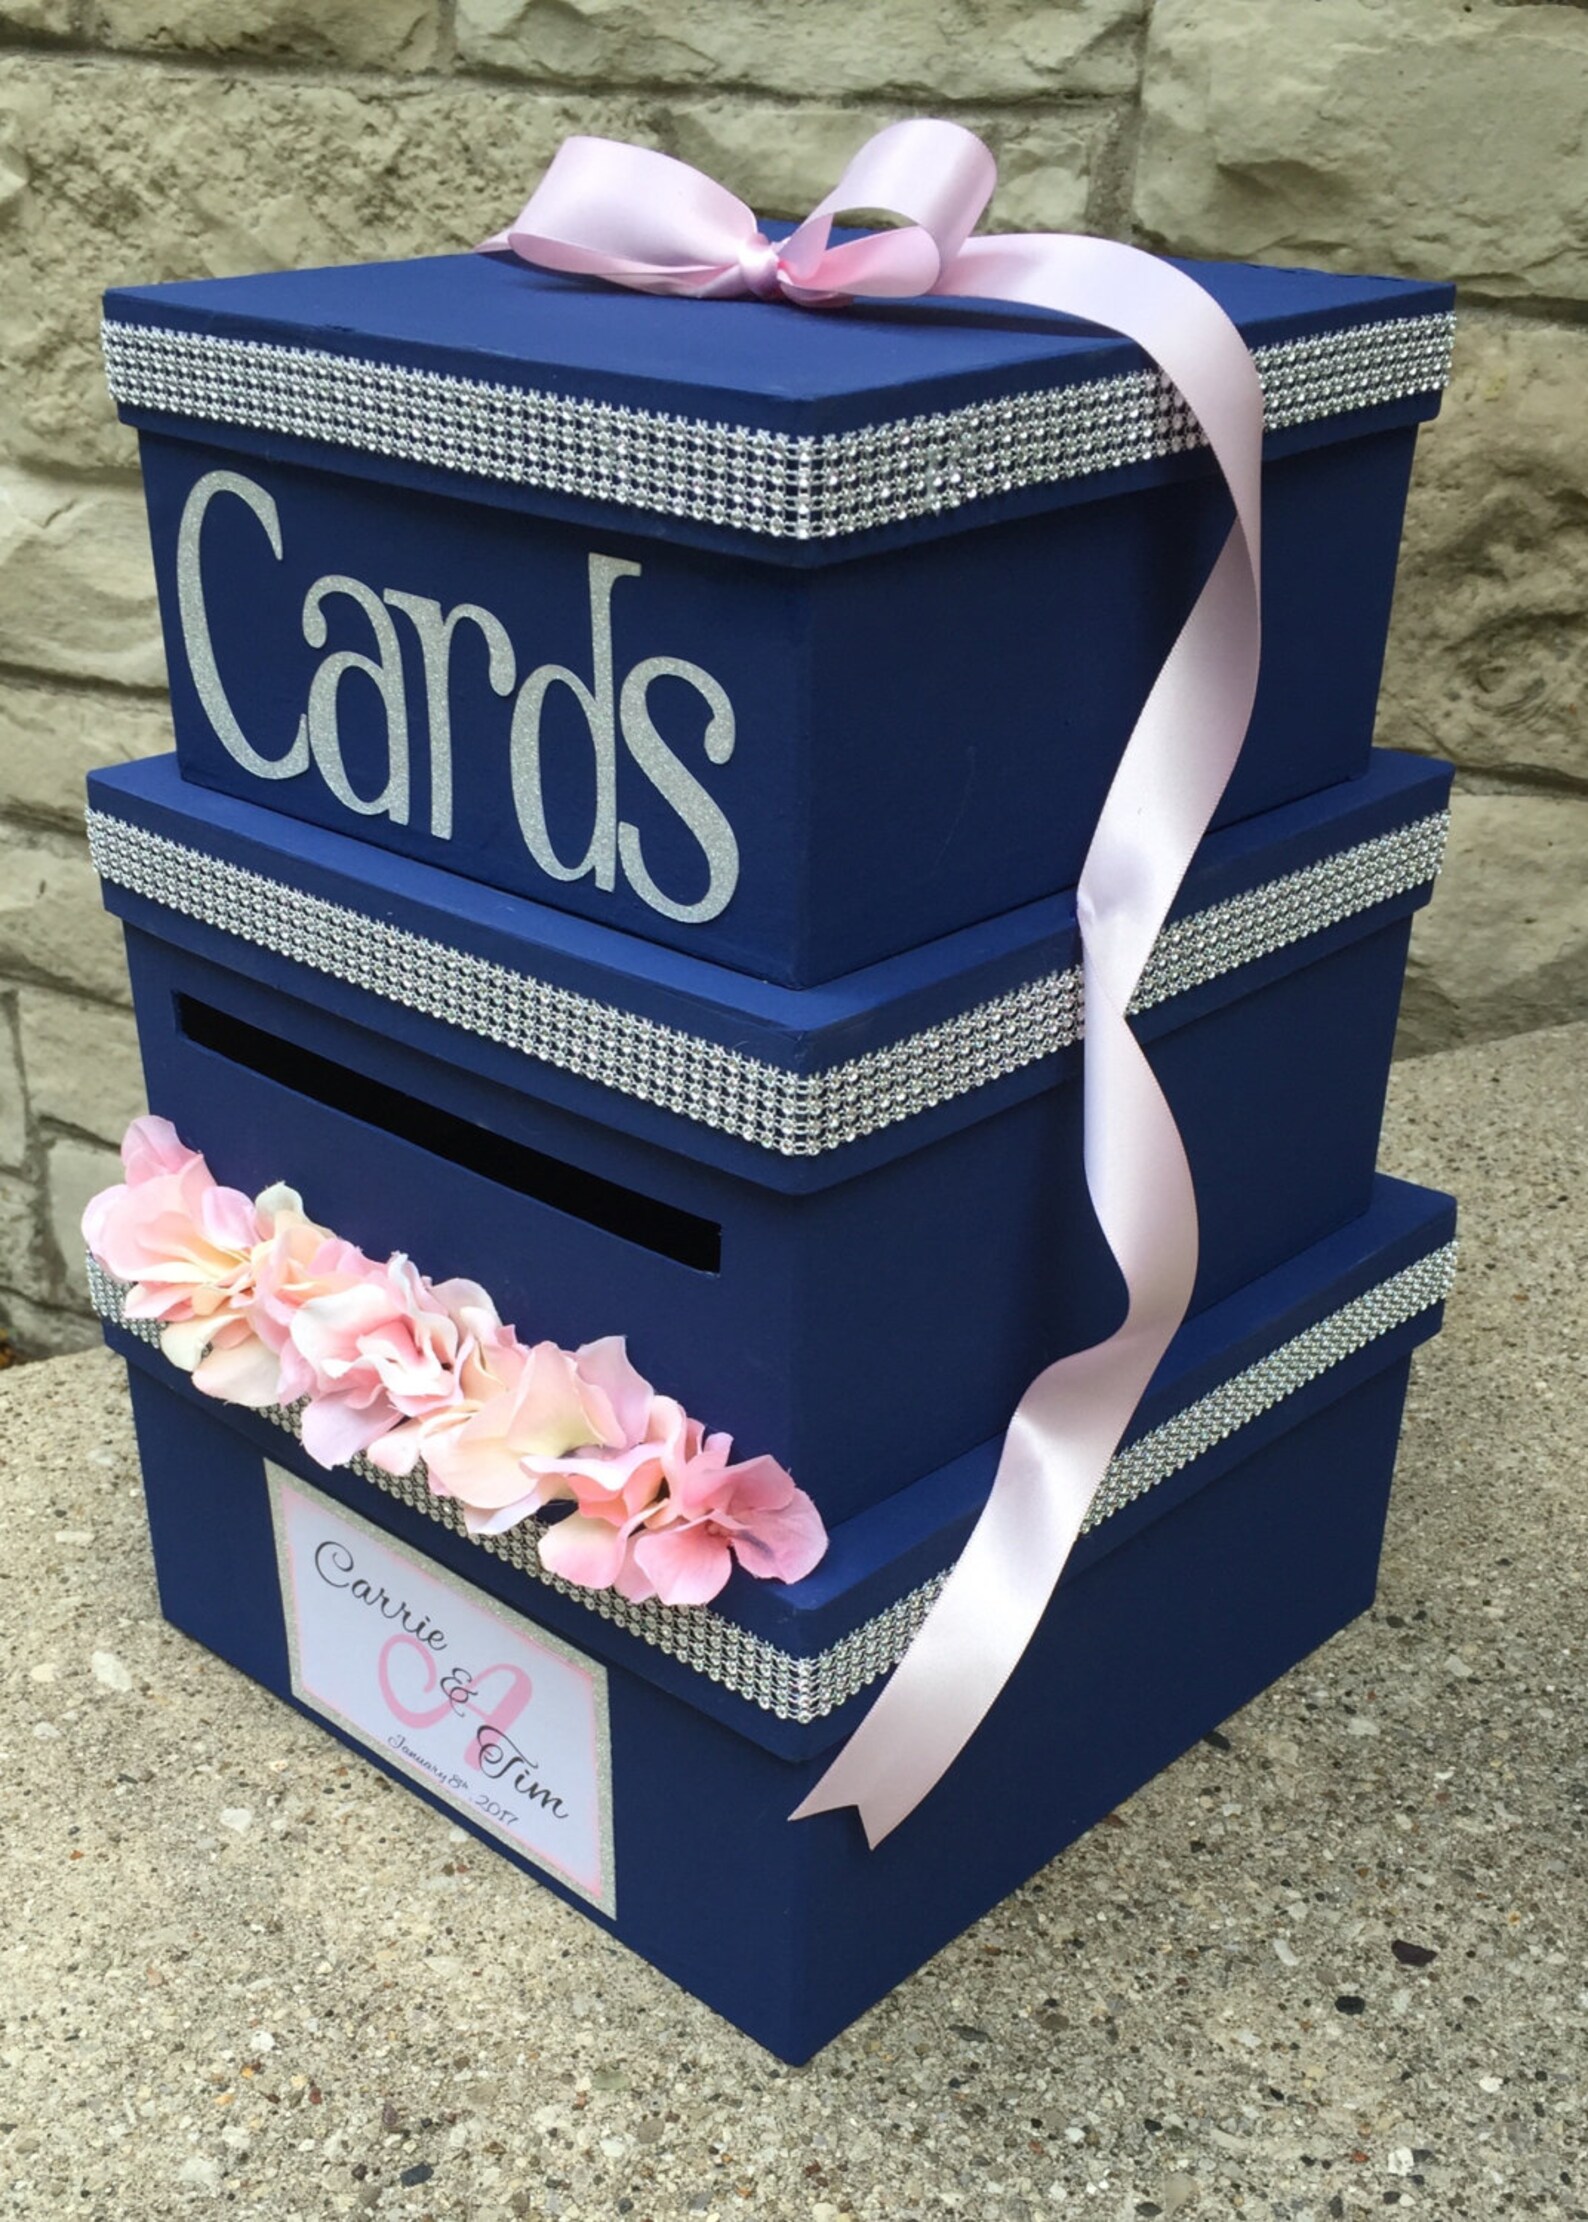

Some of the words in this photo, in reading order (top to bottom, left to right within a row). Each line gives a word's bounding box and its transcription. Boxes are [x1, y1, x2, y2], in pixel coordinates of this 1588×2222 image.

[177, 469, 739, 924] Cards
[314, 1540, 448, 1651] Carrie
[440, 1667, 479, 1718] &
[387, 1734, 448, 1783] January
[475, 1794, 519, 1826] 2017
[476, 1724, 570, 1819] Tim
